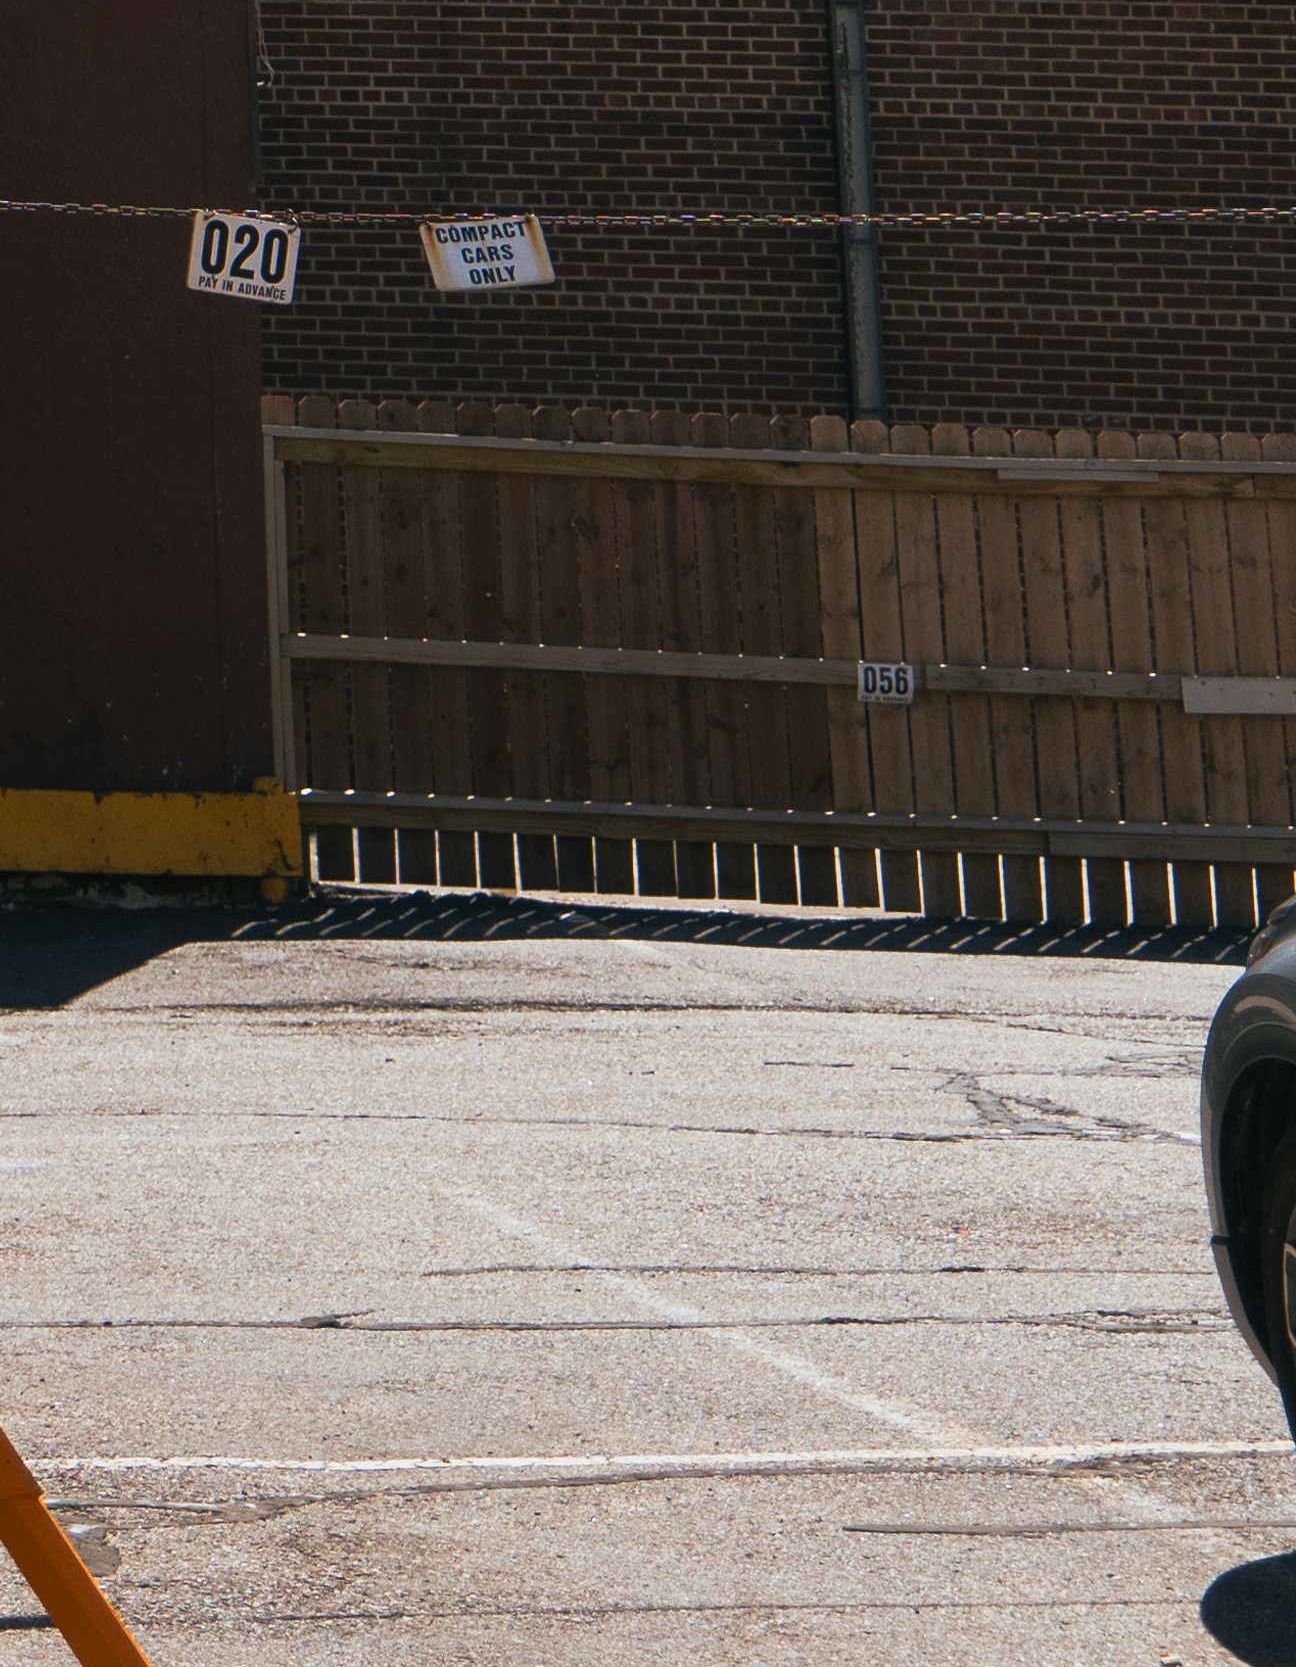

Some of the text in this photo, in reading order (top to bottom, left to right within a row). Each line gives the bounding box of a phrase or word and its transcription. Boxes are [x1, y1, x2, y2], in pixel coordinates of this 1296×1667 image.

[434, 221, 527, 244] COMPACT
[200, 219, 289, 285] 020
[461, 243, 514, 265] CARS
[468, 264, 517, 285] ONLY
[198, 275, 287, 301] PAY IN ADVANCE
[863, 665, 909, 695] 056
